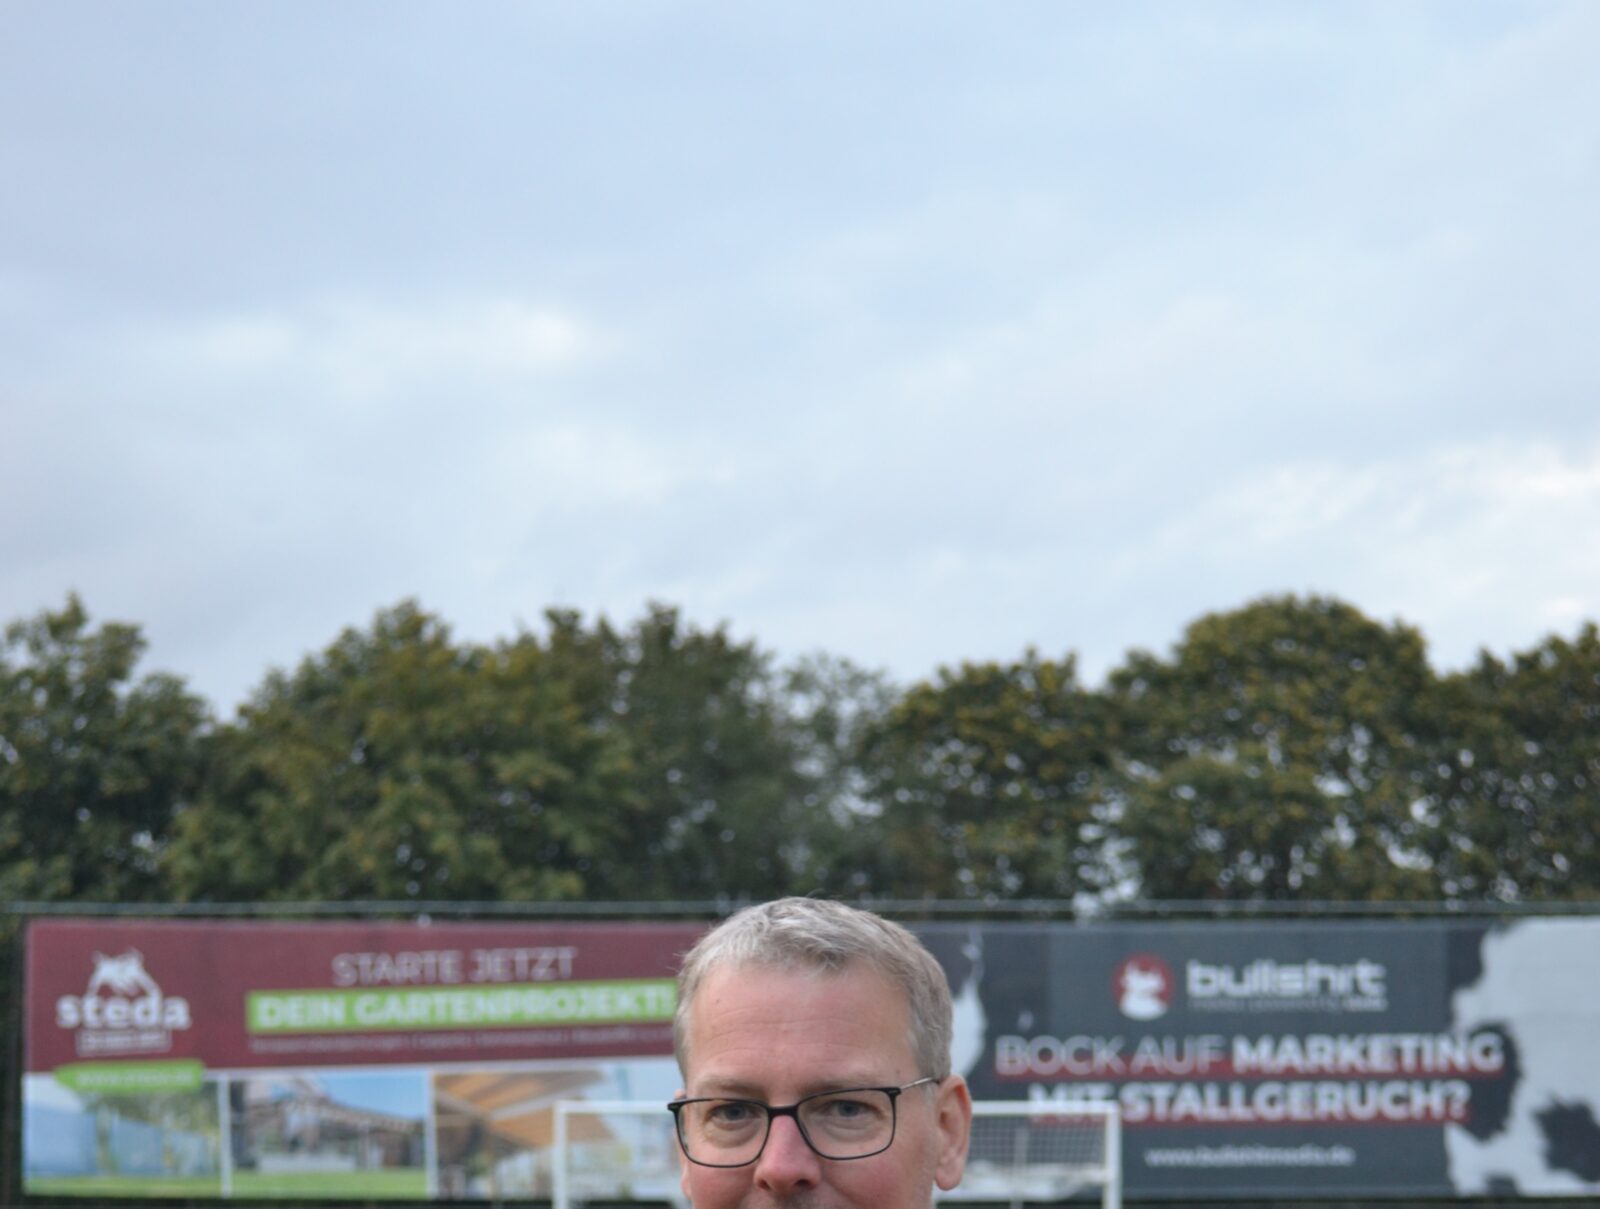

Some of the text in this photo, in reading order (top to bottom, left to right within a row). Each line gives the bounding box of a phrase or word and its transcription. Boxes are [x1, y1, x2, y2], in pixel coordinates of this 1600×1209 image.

[332, 947, 577, 986] STARTE JETZT
[57, 994, 190, 1031] steda
[257, 983, 675, 1028] DEIN GARTENPROJEKT!
[995, 1032, 1504, 1075] BOCK AUF MARKETING
[1120, 1079, 1471, 1122] STALLGERUCH?
